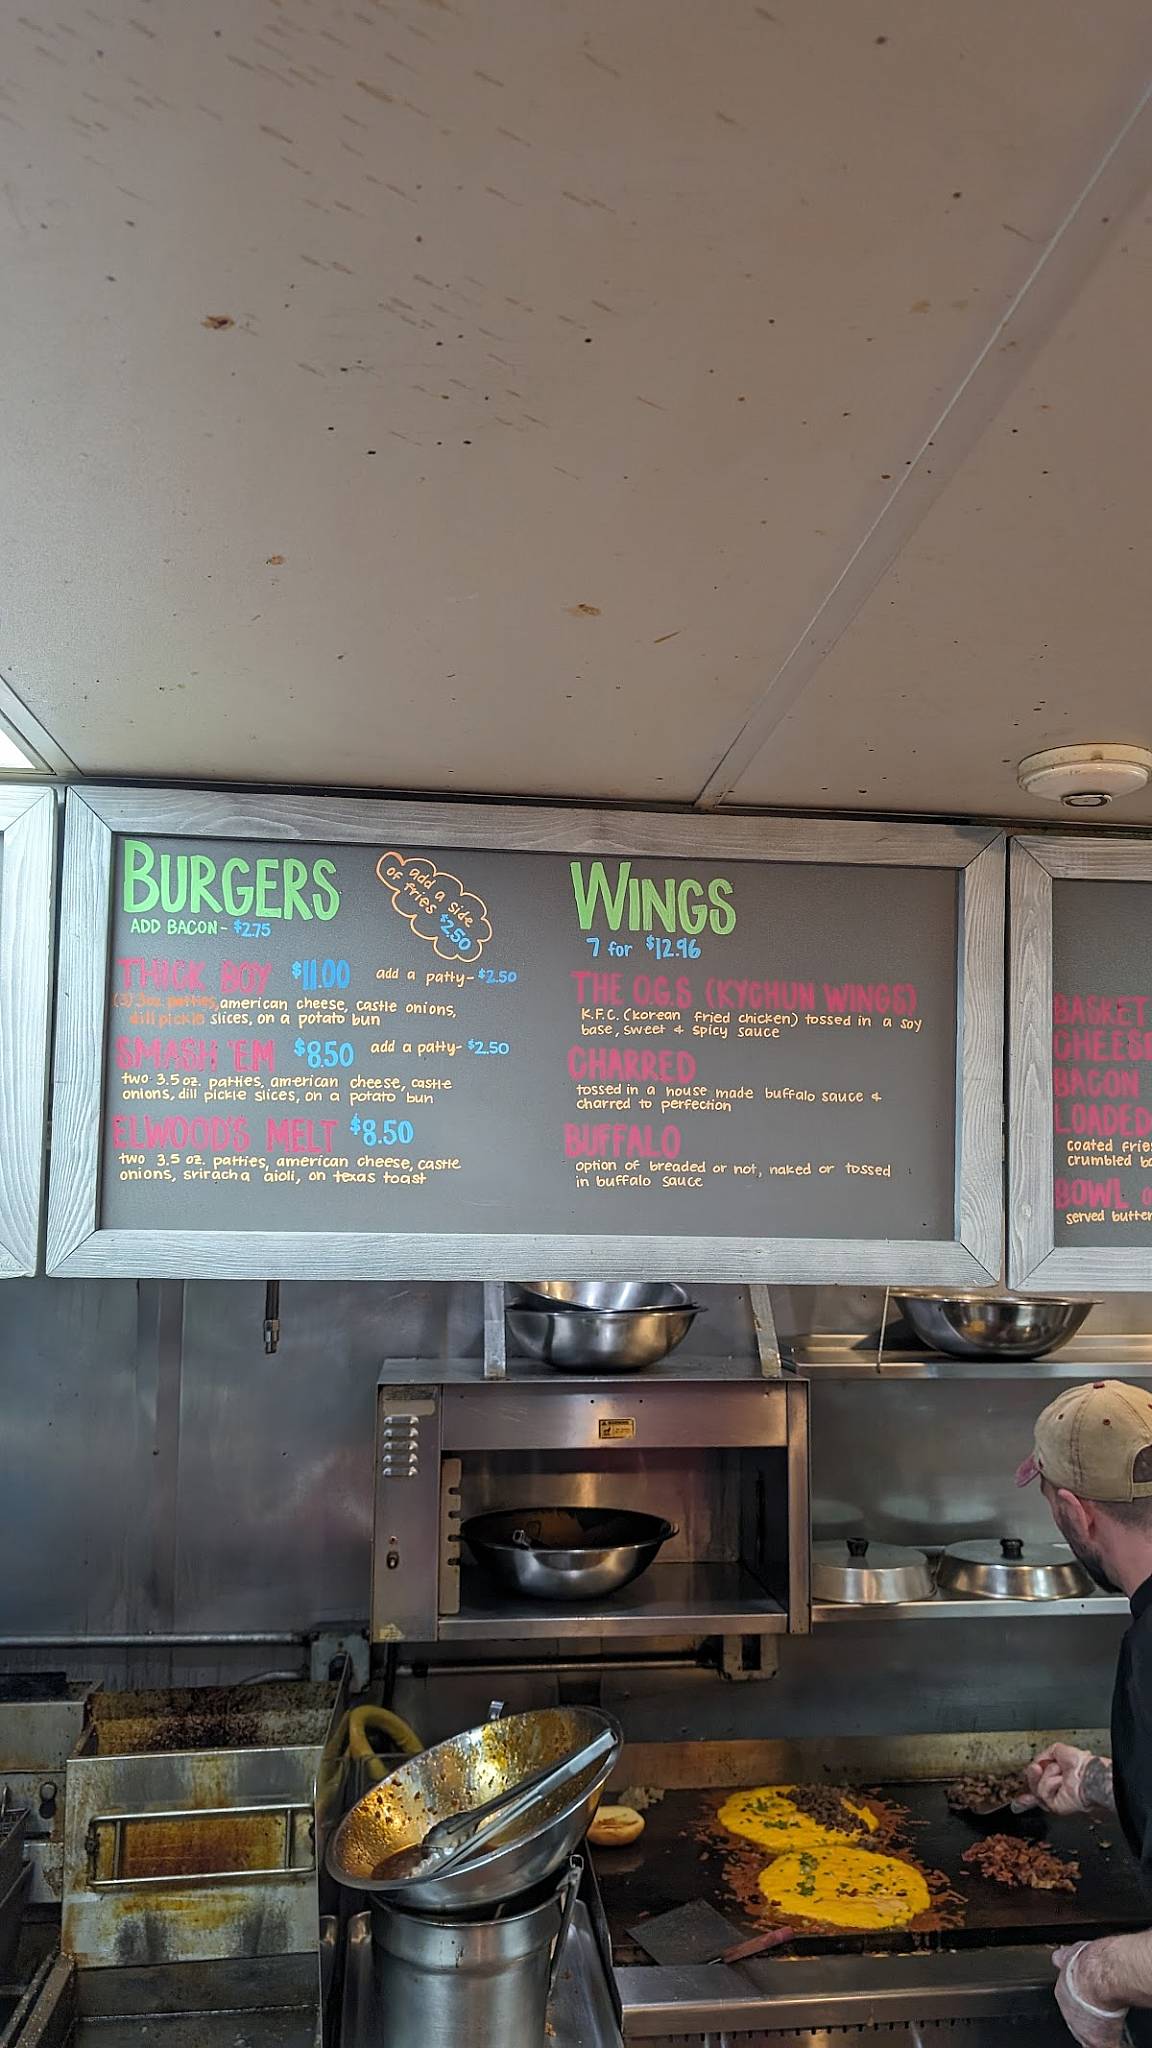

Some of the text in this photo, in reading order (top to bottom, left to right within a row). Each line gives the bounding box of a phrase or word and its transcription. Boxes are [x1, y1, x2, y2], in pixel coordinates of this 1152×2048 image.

[124, 840, 340, 921] BURGERS
[386, 867, 437, 915] of fries
[408, 868, 474, 928] add a side
[570, 861, 737, 935] WINGS
[130, 919, 161, 935] ADD
[233, 919, 272, 937] $2.75
[440, 914, 471, 950] $2.50
[586, 935, 702, 960] 7 for $12.96
[117, 957, 350, 994] THICK BOY $11.00
[376, 968, 399, 980] add
[407, 970, 416, 980] a
[478, 968, 517, 984] $2.50
[570, 970, 625, 1007] THE
[823, 982, 918, 1017] WINGS)
[210, 1011, 252, 1026] slices,
[257, 1013, 275, 1025] on
[280, 1014, 290, 1025] a
[298, 1012, 345, 1028] potato
[352, 1013, 381, 1026] bun
[220, 997, 288, 1011] american
[296, 997, 348, 1014] cheese,
[405, 1001, 457, 1019] onions,
[581, 1007, 922, 1032] K.F.C. (korean fried chicken) tossed in a soy
[1053, 992, 1149, 1028] BASKET
[581, 1024, 620, 1038] base,
[623, 1024, 666, 1035] sweet
[692, 1024, 728, 1039] spicy
[737, 1026, 780, 1038] sauce
[115, 1035, 218, 1073] SMASH
[294, 1037, 355, 1069] $8.50
[370, 1039, 395, 1054] add
[402, 1043, 412, 1054] a
[467, 1038, 510, 1055] $2.50
[567, 1044, 698, 1085] CHARRED
[121, 1072, 149, 1085] two
[156, 1073, 180, 1086] 3.5
[183, 1075, 201, 1087] oz.
[270, 1074, 339, 1088] american
[350, 1074, 406, 1092] cheese,
[576, 1084, 622, 1096] tossed
[626, 1083, 639, 1096] in
[646, 1085, 656, 1096] a
[666, 1085, 708, 1097] house
[715, 1087, 754, 1099] made
[765, 1087, 816, 1102] buffalo
[821, 1091, 864, 1103] sauce
[1053, 1067, 1140, 1098] BACON
[122, 1087, 434, 1106] onions, dill pickle slices, on a potato bun
[576, 1098, 732, 1114] charred to perfection
[1054, 1102, 1152, 1137] LOADED
[112, 1113, 414, 1154] ELWOOD'S MELT $8.50
[564, 1121, 682, 1159] BUFFALO
[1066, 1139, 1113, 1152] coated
[119, 1153, 145, 1166] two
[157, 1153, 181, 1167] 3.5
[185, 1155, 206, 1167] oz.
[213, 1154, 270, 1171] patties,
[276, 1155, 348, 1168] american
[357, 1155, 414, 1171] cheese,
[575, 1159, 891, 1178] option of breaded or not, naked or tossed
[1067, 1154, 1132, 1167] crumbled
[119, 1168, 177, 1183] onions,
[263, 1170, 301, 1184] aioli,
[309, 1171, 326, 1182] on
[333, 1171, 376, 1184] texas
[383, 1171, 427, 1185] toast
[576, 1175, 704, 1188] in buffalo sauce
[1054, 1177, 1130, 1210] BOWL
[1066, 1209, 1105, 1225] served
